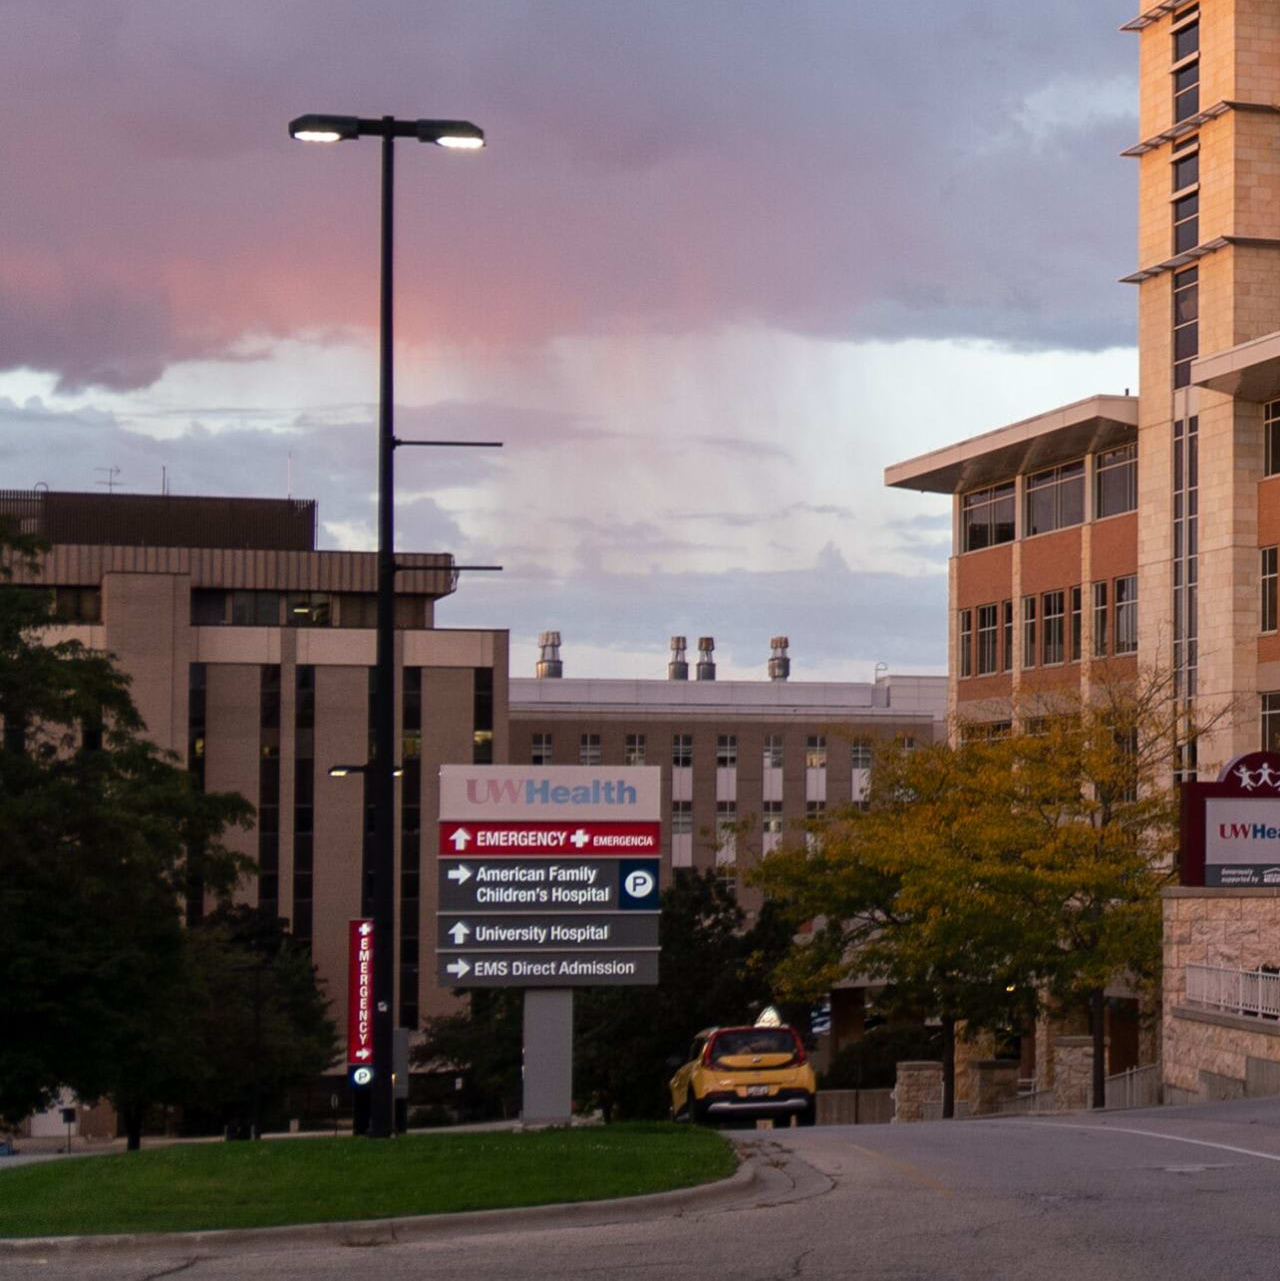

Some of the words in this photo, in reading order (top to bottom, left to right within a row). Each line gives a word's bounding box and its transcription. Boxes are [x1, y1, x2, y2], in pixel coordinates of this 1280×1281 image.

[466, 779, 637, 804] UWHealth
[476, 830, 567, 847] EMERGENCY
[592, 835, 654, 847] EMERGENCIA
[476, 866, 545, 882] American
[549, 866, 597, 884] Family
[632, 876, 647, 893] P
[476, 886, 548, 903] Children's
[551, 886, 610, 904] Hospital
[475, 926, 547, 943] University
[550, 925, 609, 942] Hospital
[474, 960, 508, 976] EMS
[512, 960, 556, 976] Direct
[558, 959, 635, 976] Admission
[359, 937, 370, 1044] EMERGENCY
